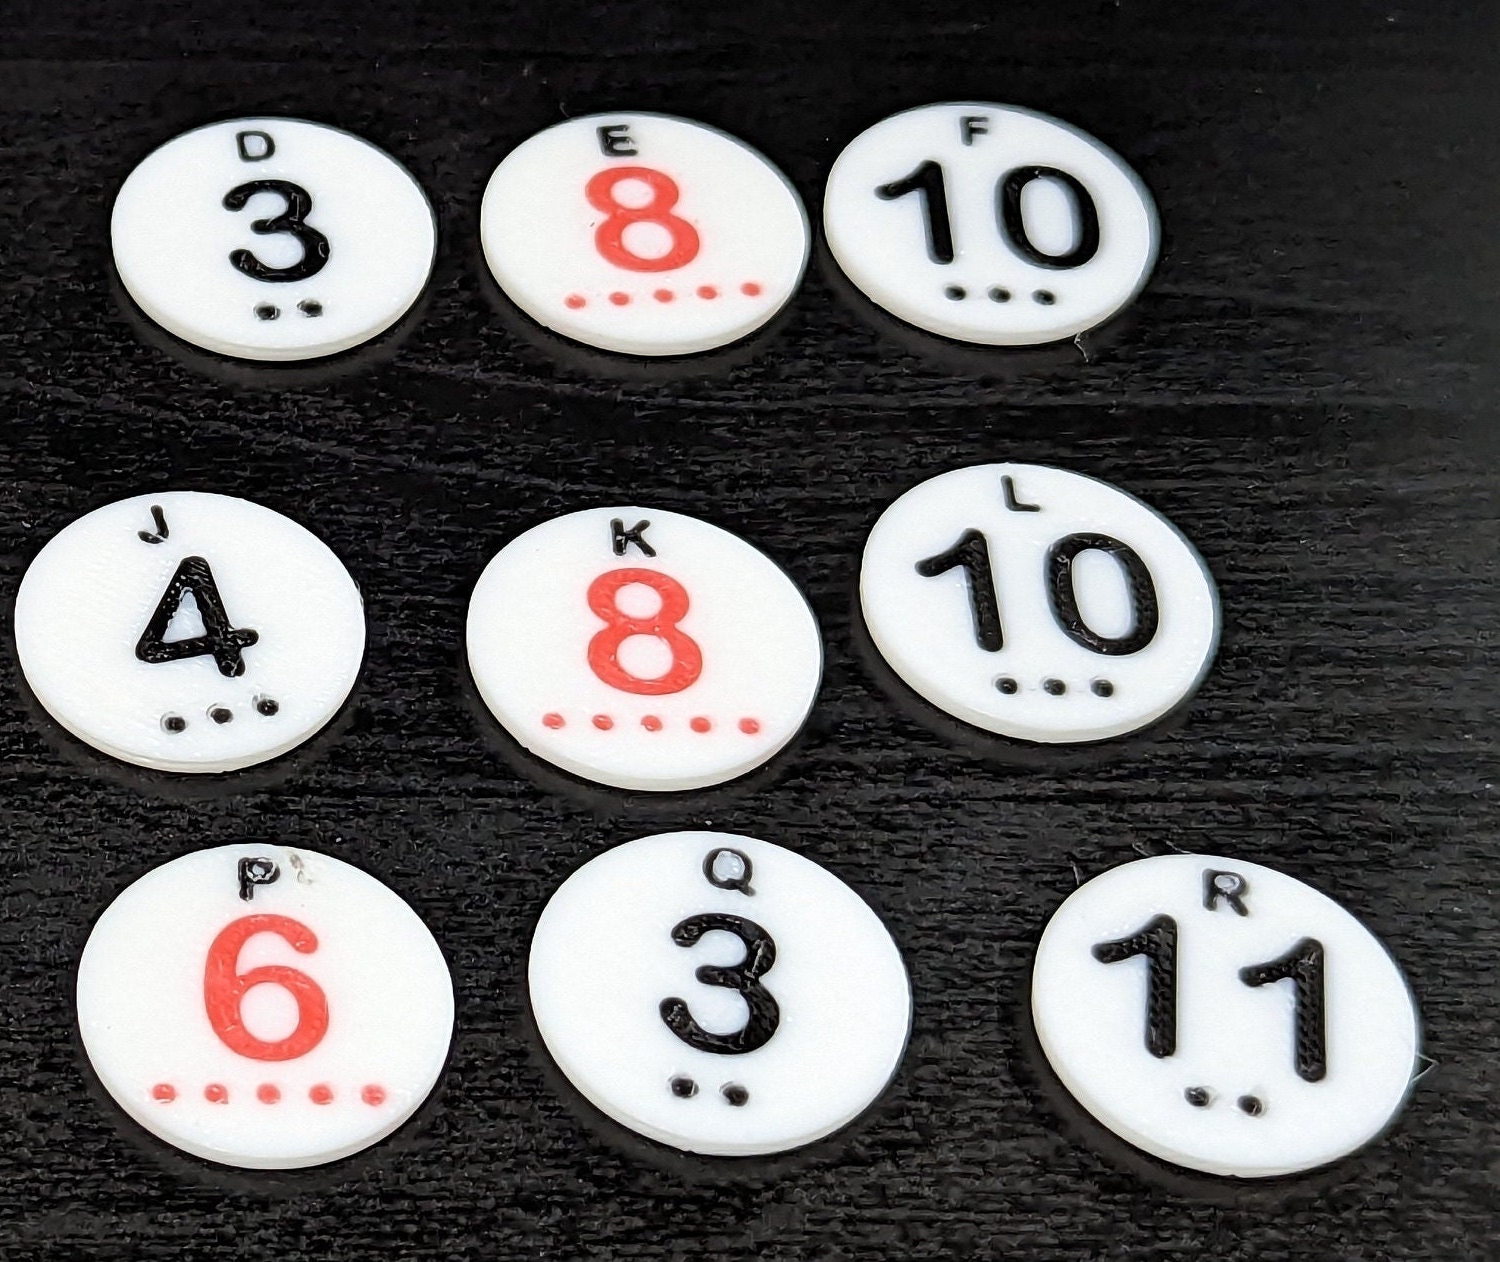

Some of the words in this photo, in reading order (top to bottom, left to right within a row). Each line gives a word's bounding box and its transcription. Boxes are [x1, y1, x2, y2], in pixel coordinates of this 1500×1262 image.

[235, 130, 277, 163] D
[595, 124, 639, 158] E
[958, 115, 990, 147] F
[221, 178, 331, 284] 3
[586, 166, 701, 273] 8
[874, 159, 1101, 271] 10
[137, 505, 171, 545] J
[1000, 475, 1041, 513] L
[609, 518, 657, 558] K
[134, 555, 260, 679] 4
[587, 567, 703, 696] 8
[914, 528, 1160, 657] 10
[237, 856, 281, 902] P
[702, 847, 756, 897] Q
[1202, 868, 1249, 917] R
[203, 913, 330, 1062] 6
[658, 912, 781, 1056] 3
[1091, 914, 1328, 1084] 11
